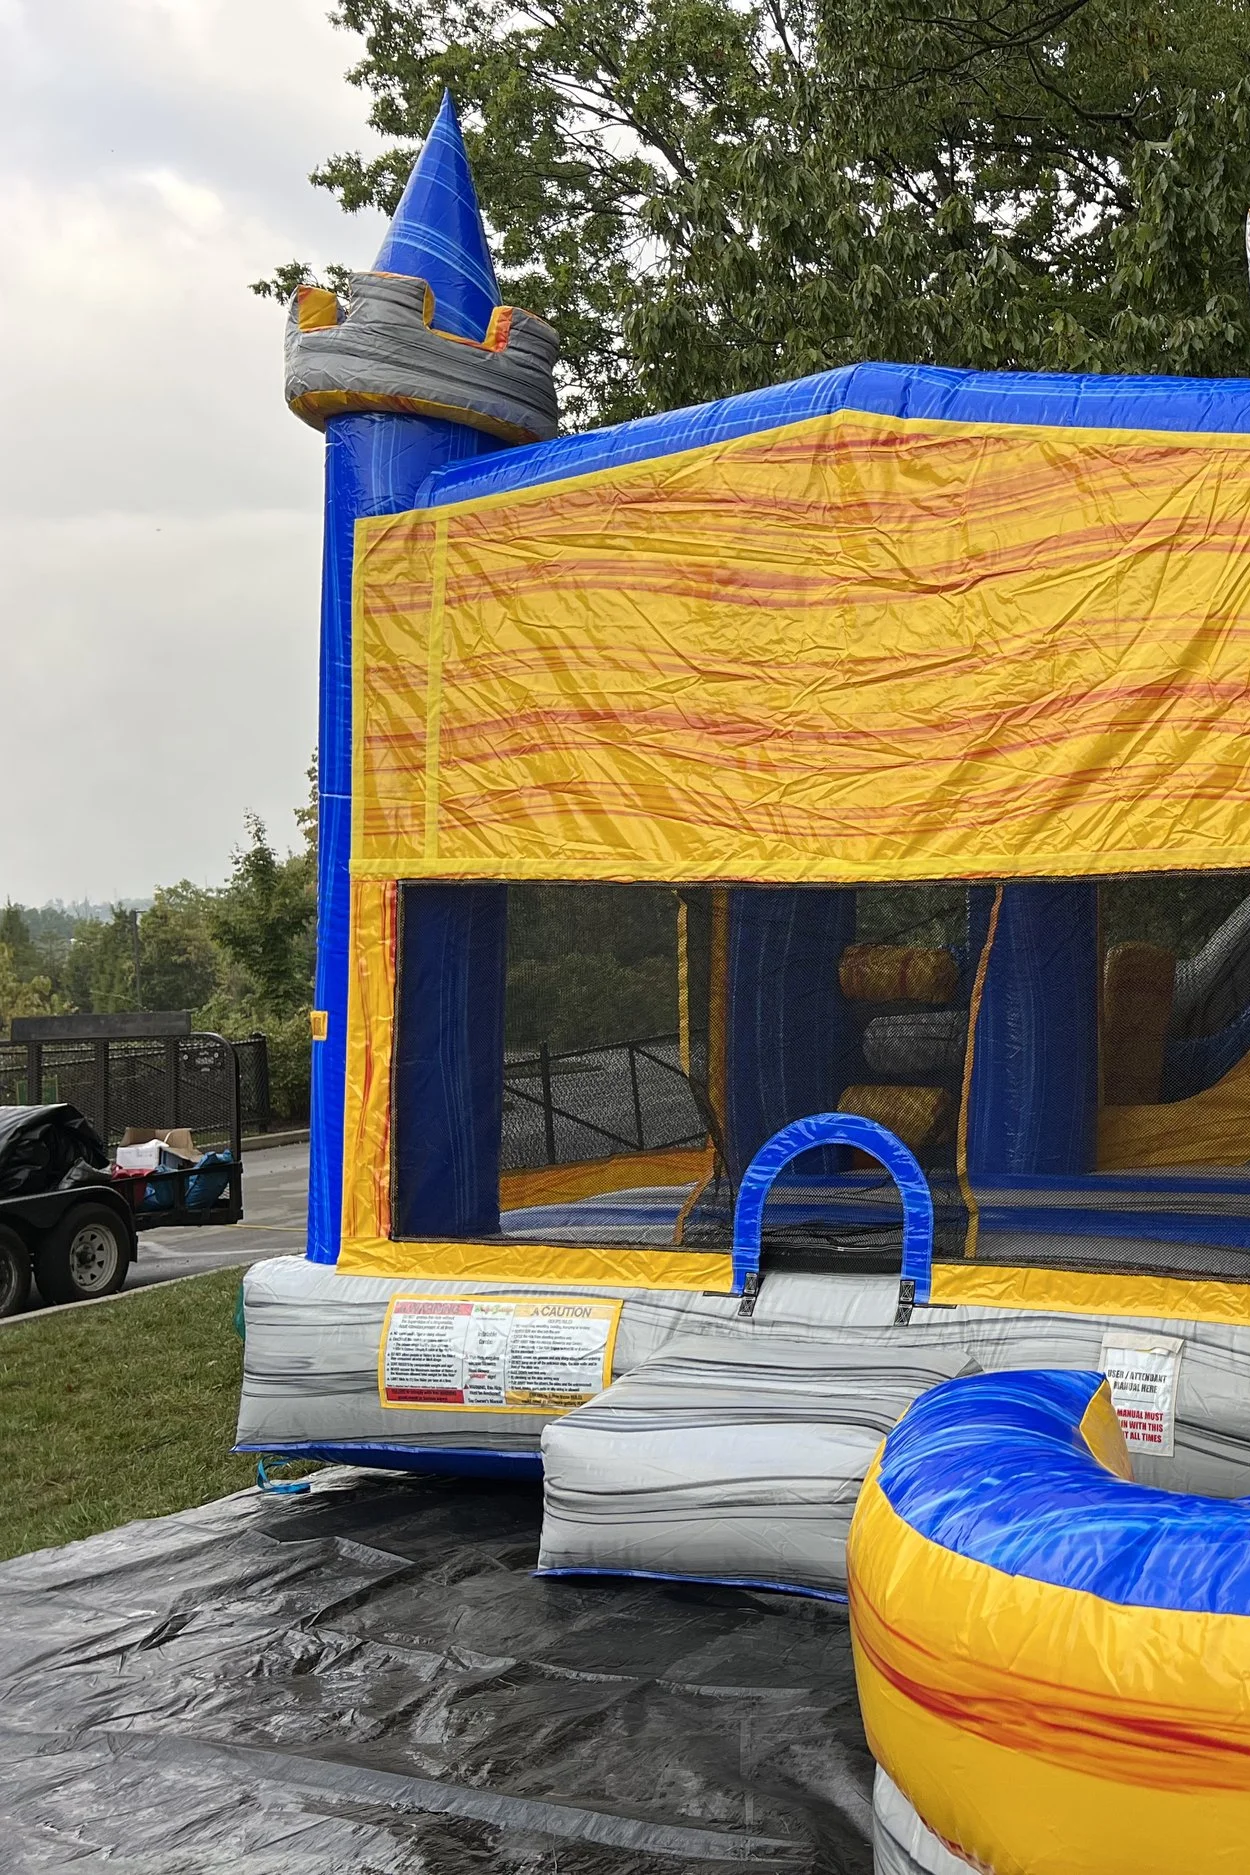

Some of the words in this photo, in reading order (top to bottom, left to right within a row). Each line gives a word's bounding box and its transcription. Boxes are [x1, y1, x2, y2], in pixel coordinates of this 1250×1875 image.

[541, 1305, 592, 1318] CAUTION
[1107, 1369, 1124, 1379] USER
[1130, 1371, 1167, 1383] ATTENDANT
[1113, 1381, 1140, 1392] MANUAL
[1141, 1383, 1157, 1394] HERE
[1116, 1409, 1143, 1419] MANUAL
[1145, 1411, 1163, 1421] MUST
[1129, 1421, 1146, 1431] WITH
[1148, 1423, 1163, 1432] THIS
[1130, 1432, 1140, 1441] ALL
[1142, 1433, 1162, 1443] TIMES
